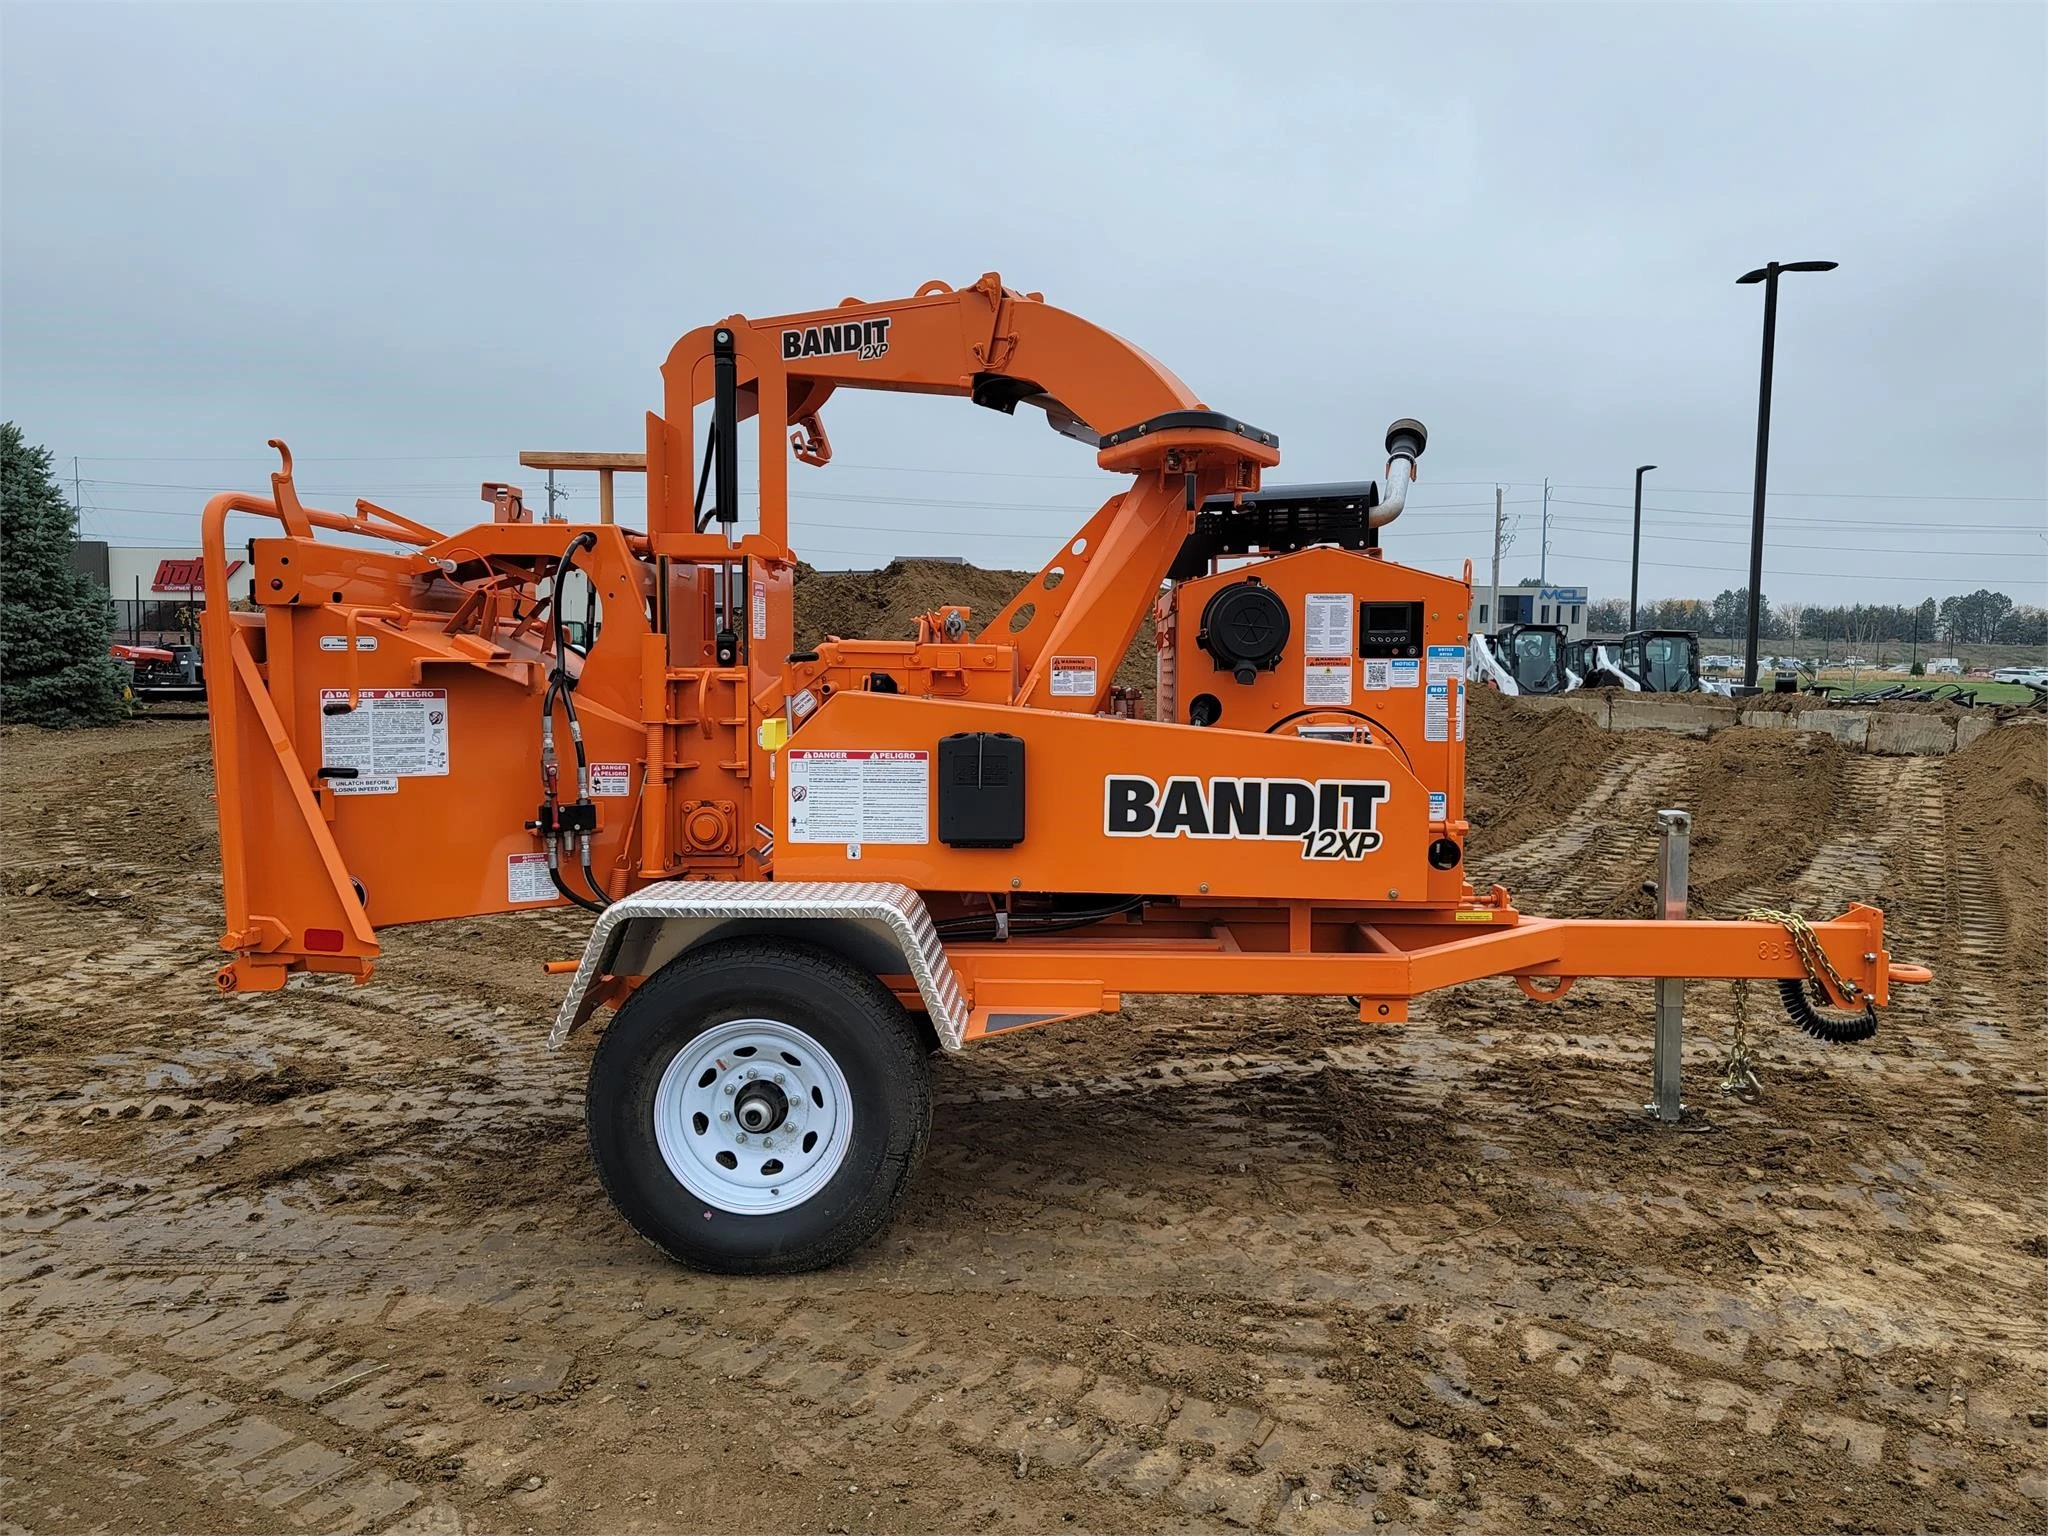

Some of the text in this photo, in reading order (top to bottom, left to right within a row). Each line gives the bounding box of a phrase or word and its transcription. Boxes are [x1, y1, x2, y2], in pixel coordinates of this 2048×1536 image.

[783, 319, 890, 359] BANDIT
[858, 344, 888, 360] 12XP
[1539, 589, 1588, 600] MCL
[1106, 777, 1387, 837] BANDIT
[1301, 830, 1380, 859] 12XP
